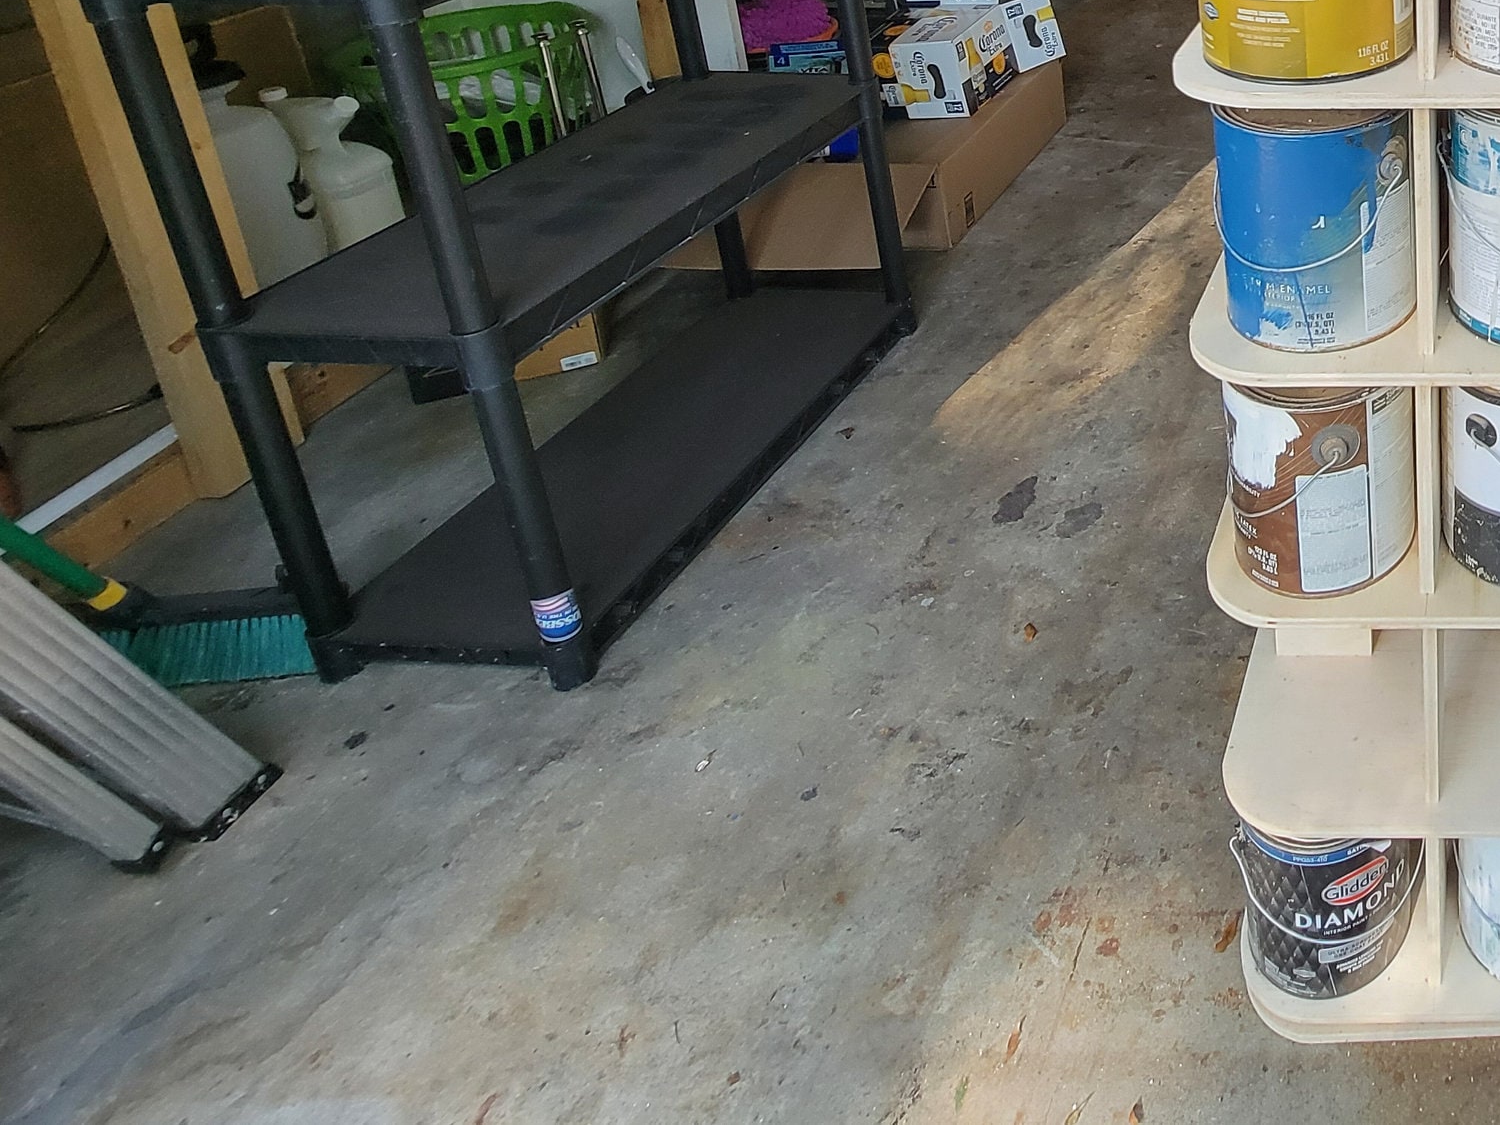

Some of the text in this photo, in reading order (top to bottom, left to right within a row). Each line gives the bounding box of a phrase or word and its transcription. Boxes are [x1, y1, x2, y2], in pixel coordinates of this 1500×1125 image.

[979, 25, 1006, 53] Corona
[1295, 859, 1405, 928] DIAMOND
[1324, 859, 1389, 900] Glidden
[1323, 924, 1351, 936] INTERIOR
